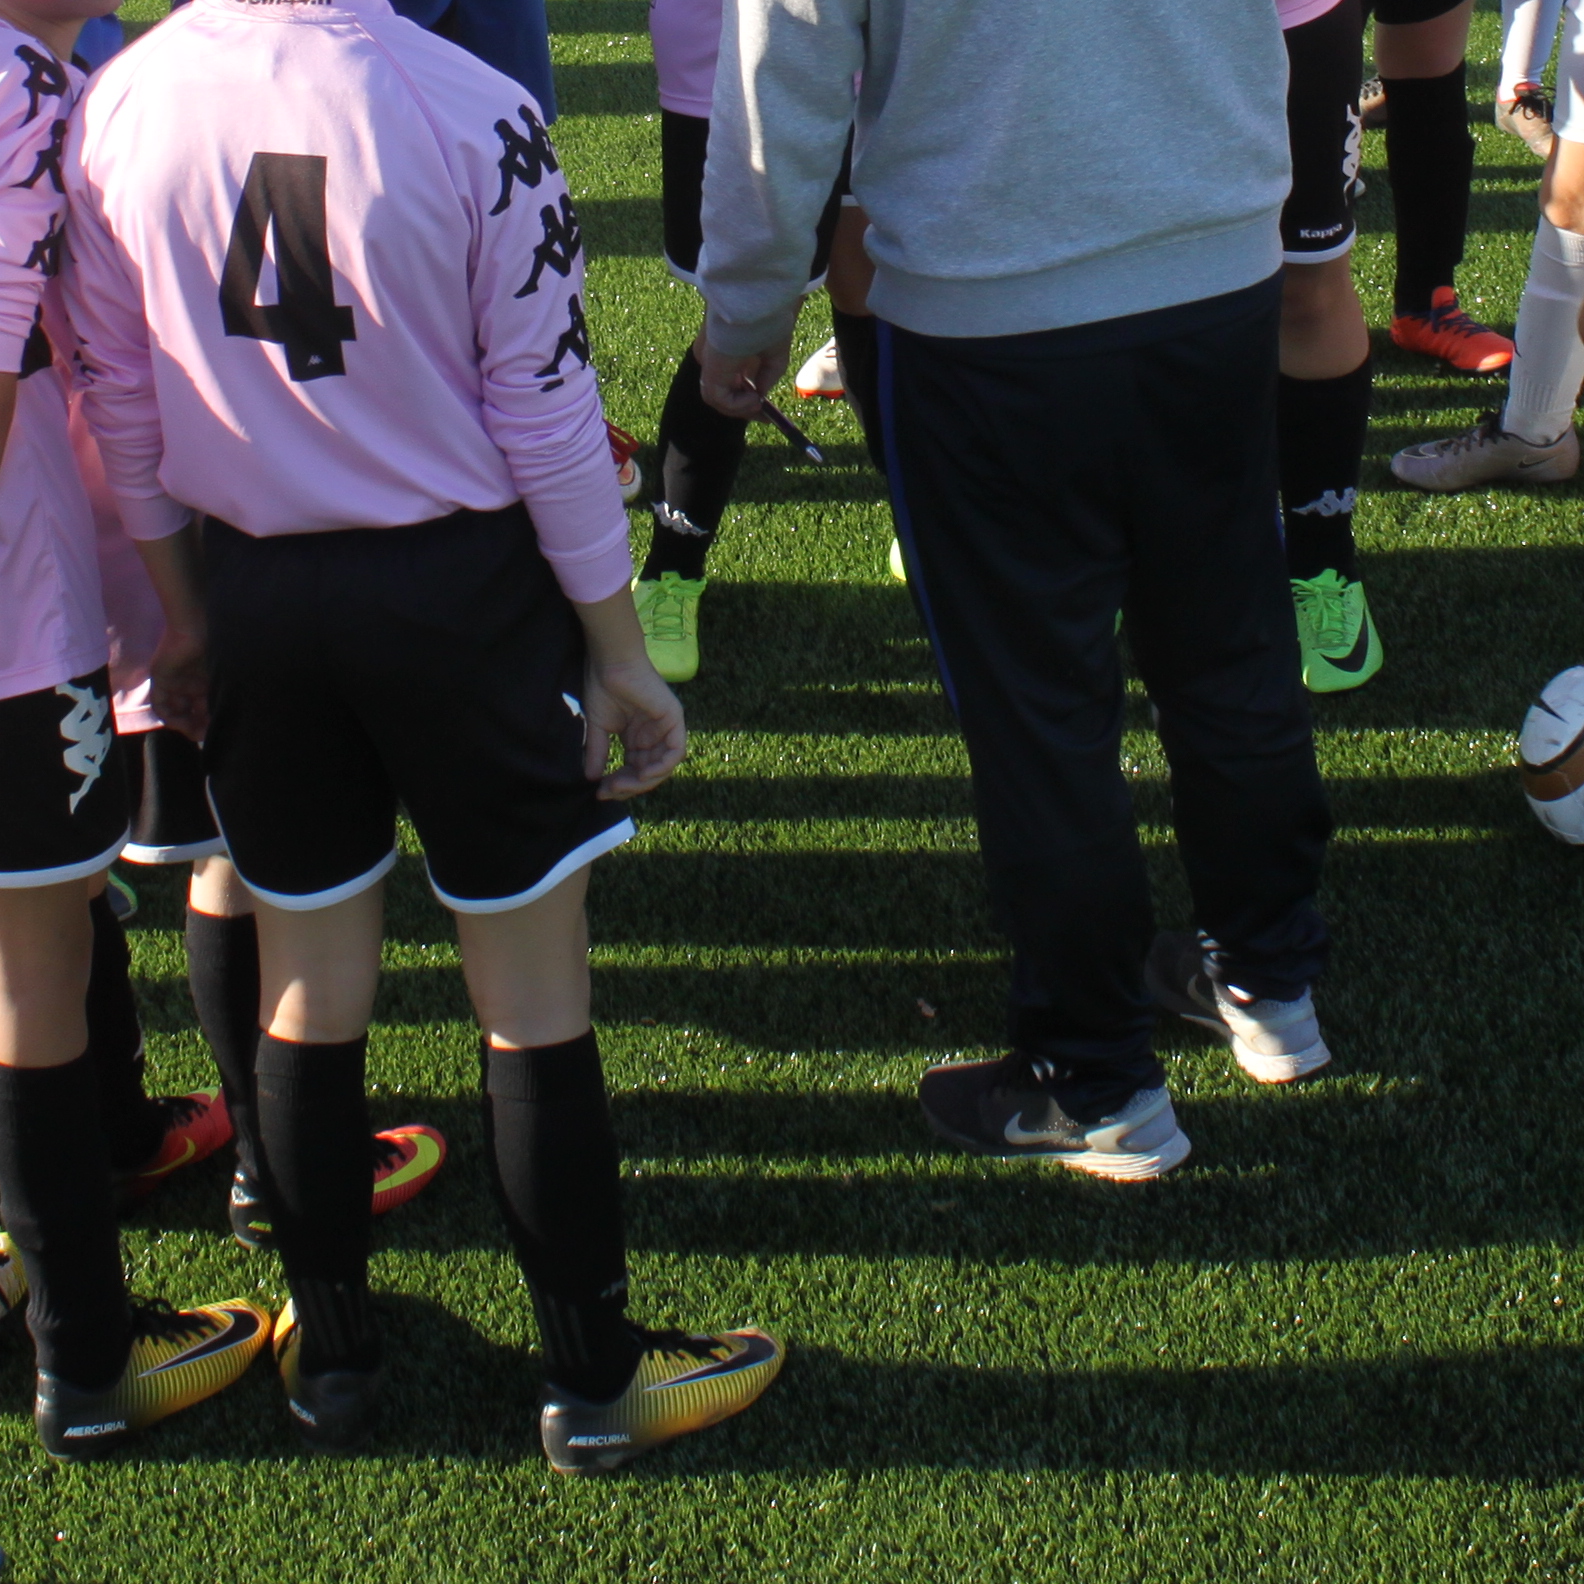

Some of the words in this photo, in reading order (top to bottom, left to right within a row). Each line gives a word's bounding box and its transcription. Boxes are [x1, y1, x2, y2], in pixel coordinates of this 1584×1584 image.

[219, 152, 356, 383] 4
[63, 1420, 127, 1438] MERCURIAL
[567, 1433, 631, 1447] MERCURIAL
